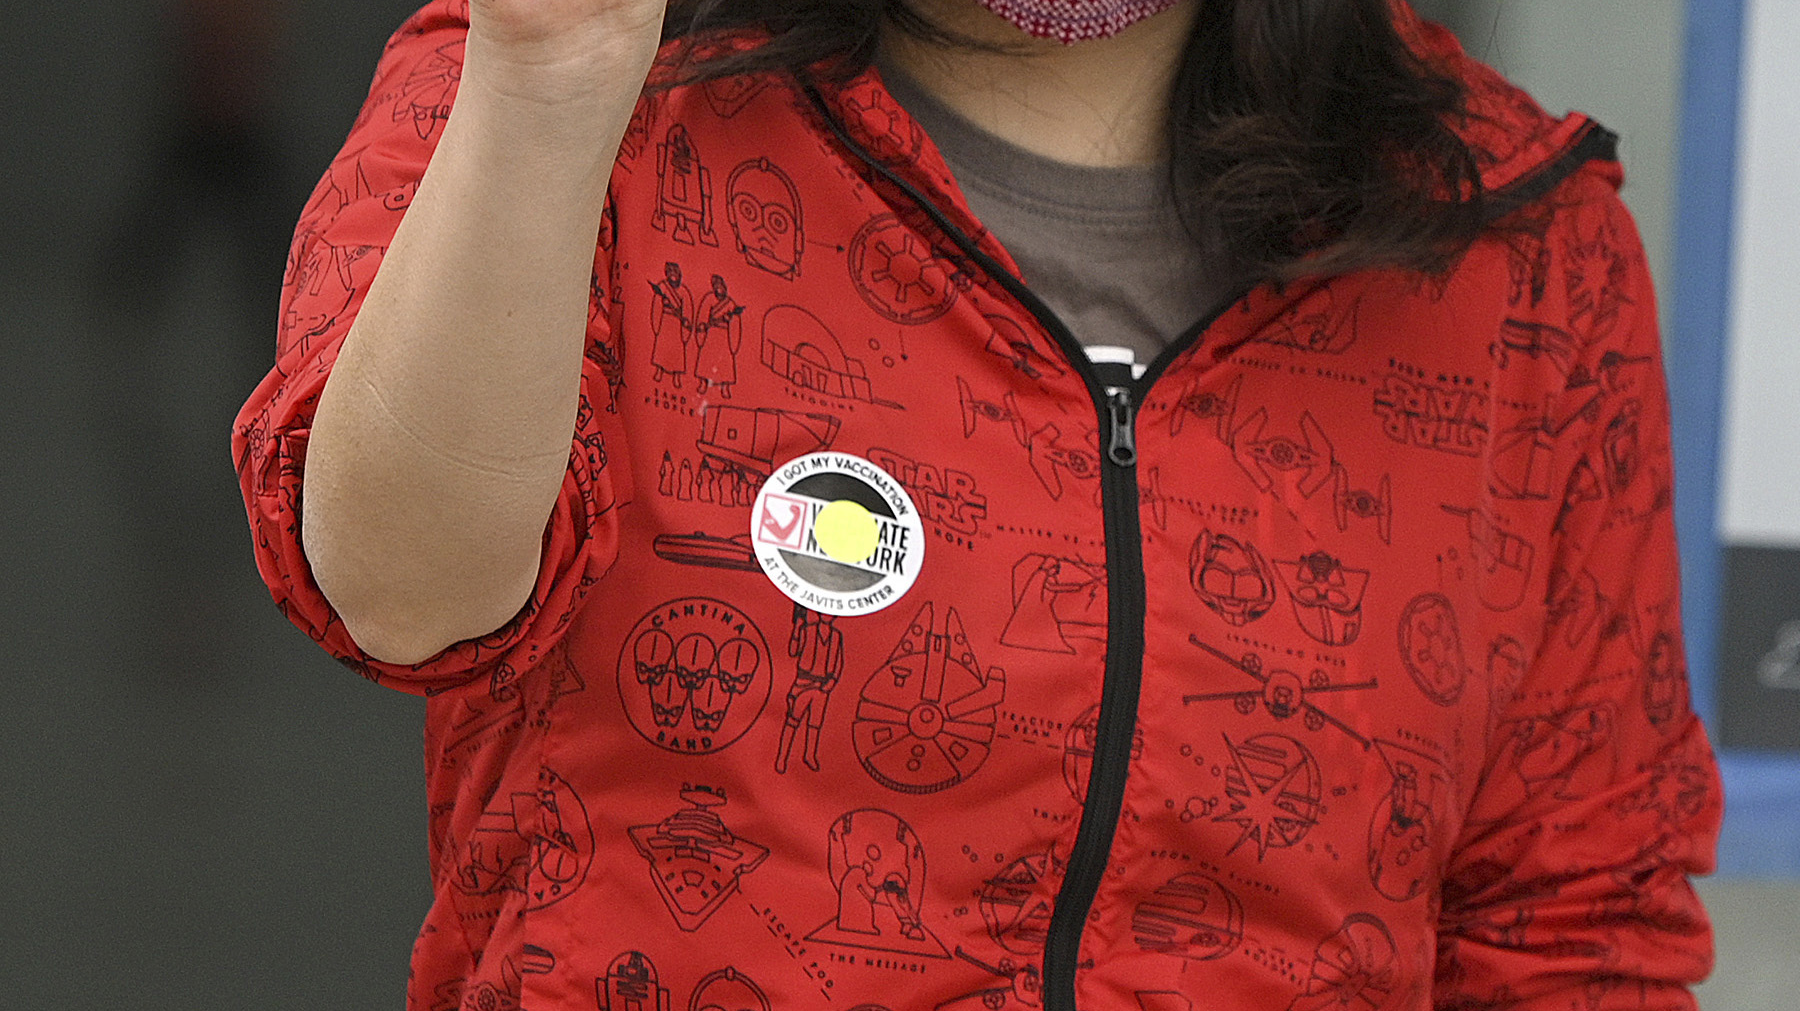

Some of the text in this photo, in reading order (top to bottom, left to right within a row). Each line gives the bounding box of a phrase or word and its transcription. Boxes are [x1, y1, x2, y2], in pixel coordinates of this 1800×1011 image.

[784, 460, 808, 480] GOT
[811, 457, 830, 469] MY
[835, 457, 909, 516] VACCINATION
[764, 557, 894, 610] AT THE JAVITS CENTER
[652, 604, 745, 636] CANTINA
[657, 731, 712, 751] BAND
